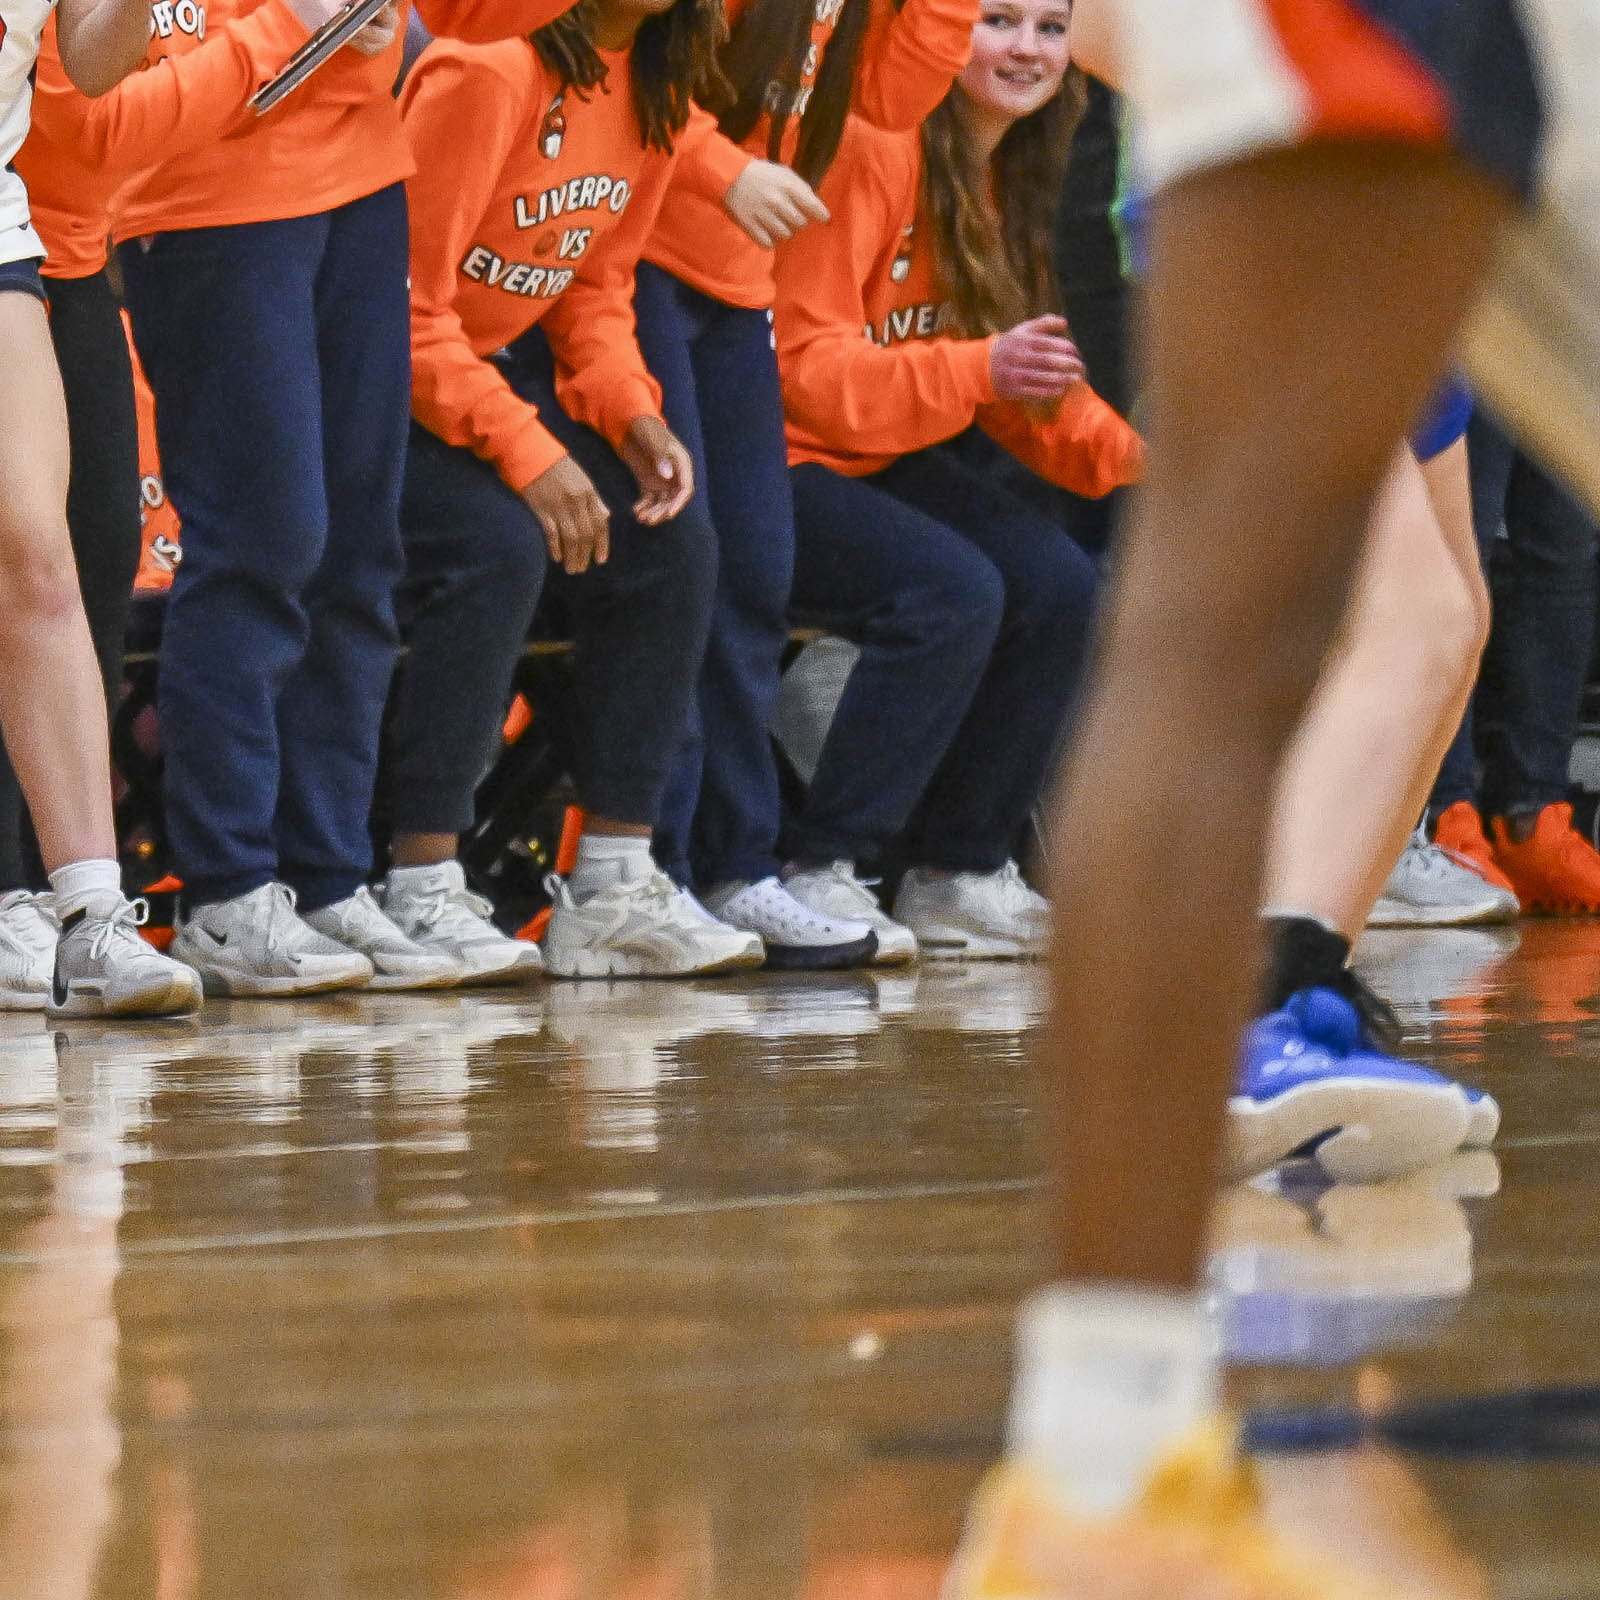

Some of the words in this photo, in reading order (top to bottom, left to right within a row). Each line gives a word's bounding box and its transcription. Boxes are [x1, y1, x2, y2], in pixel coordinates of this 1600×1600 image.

[514, 173, 631, 231] LIVERPO
[460, 244, 577, 300] EVERYB
[558, 227, 594, 261] VS
